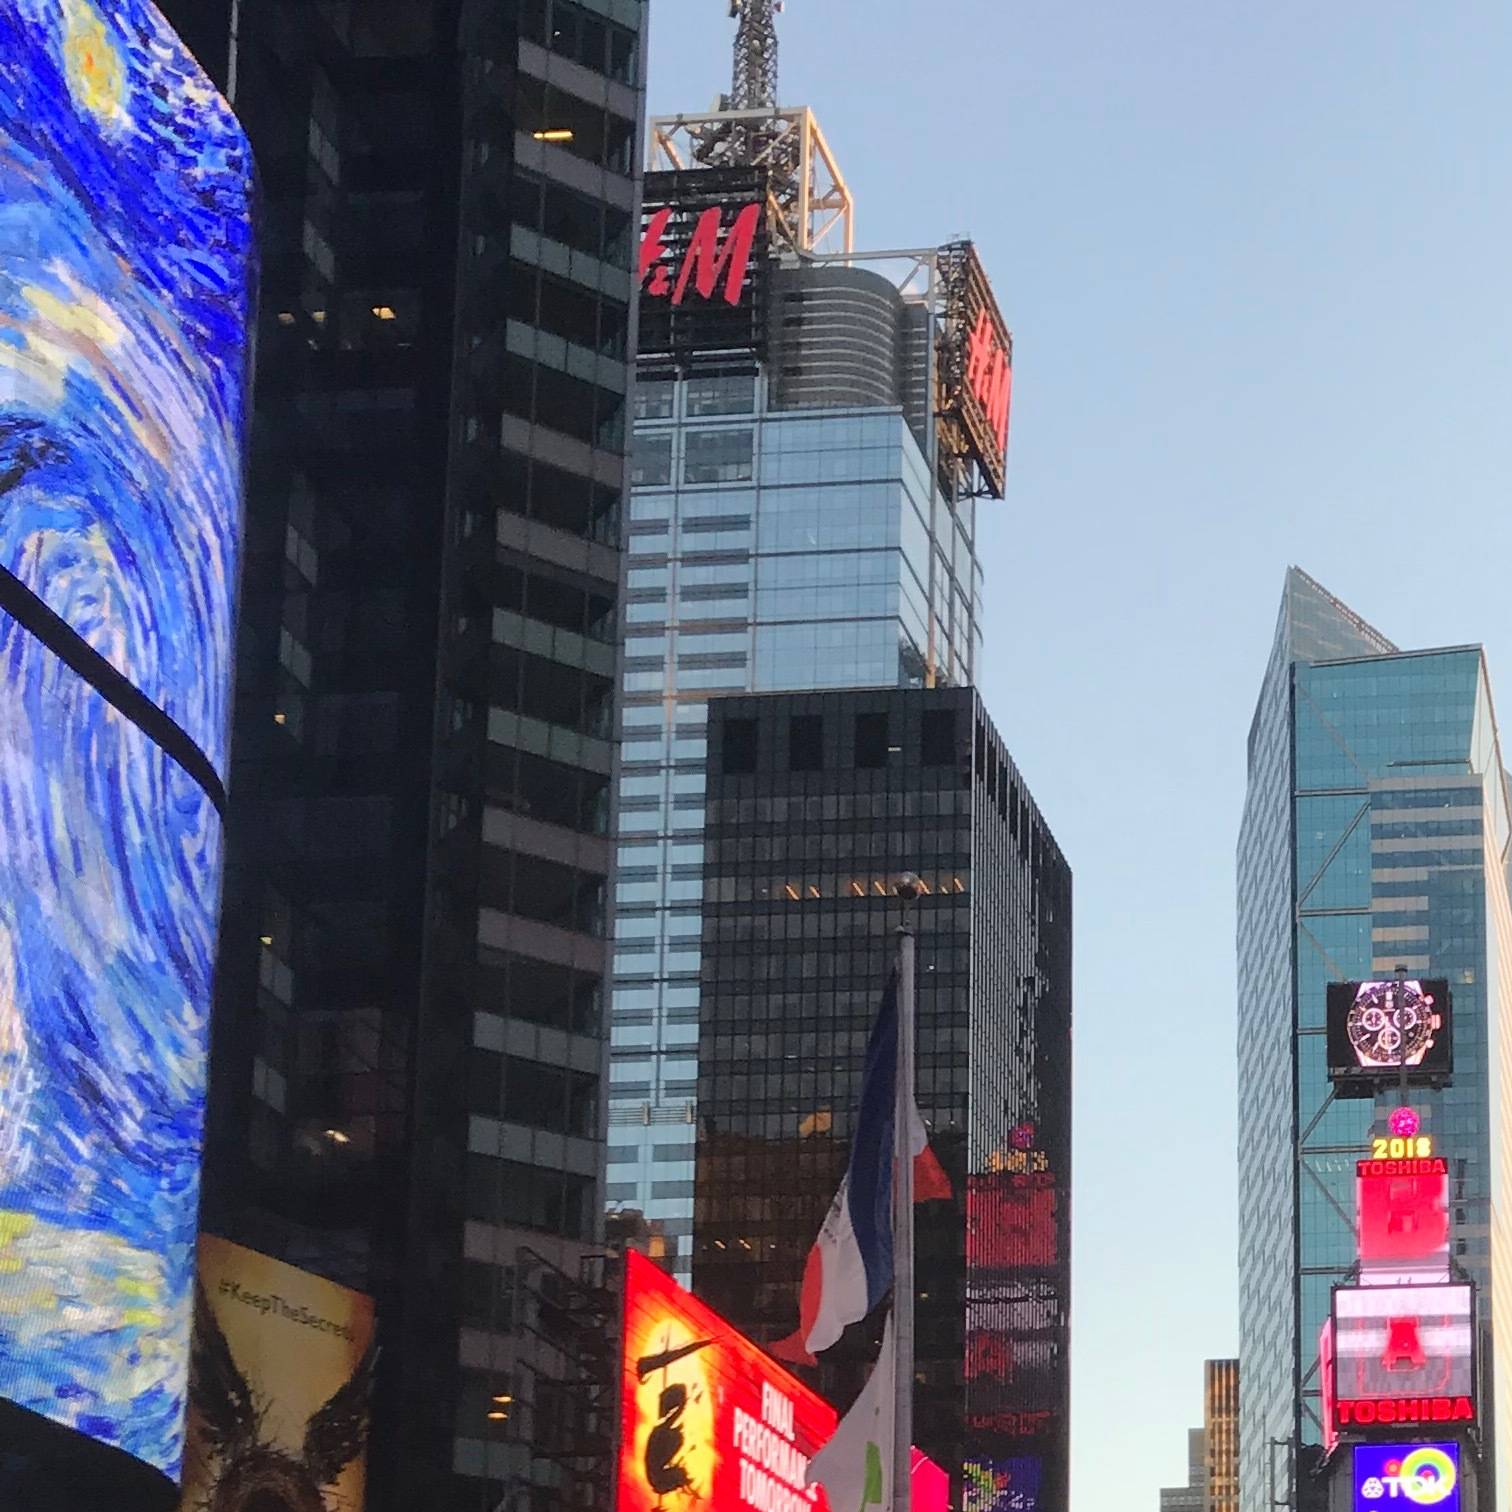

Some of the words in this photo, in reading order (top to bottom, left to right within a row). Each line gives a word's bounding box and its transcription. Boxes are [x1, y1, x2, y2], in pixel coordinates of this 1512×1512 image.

[1372, 1137, 1431, 1158] 2018
[1358, 1159, 1446, 1176] TOSHIBA
[762, 1380, 796, 1442] FINAL
[1337, 1397, 1474, 1425] TOSHIBA
